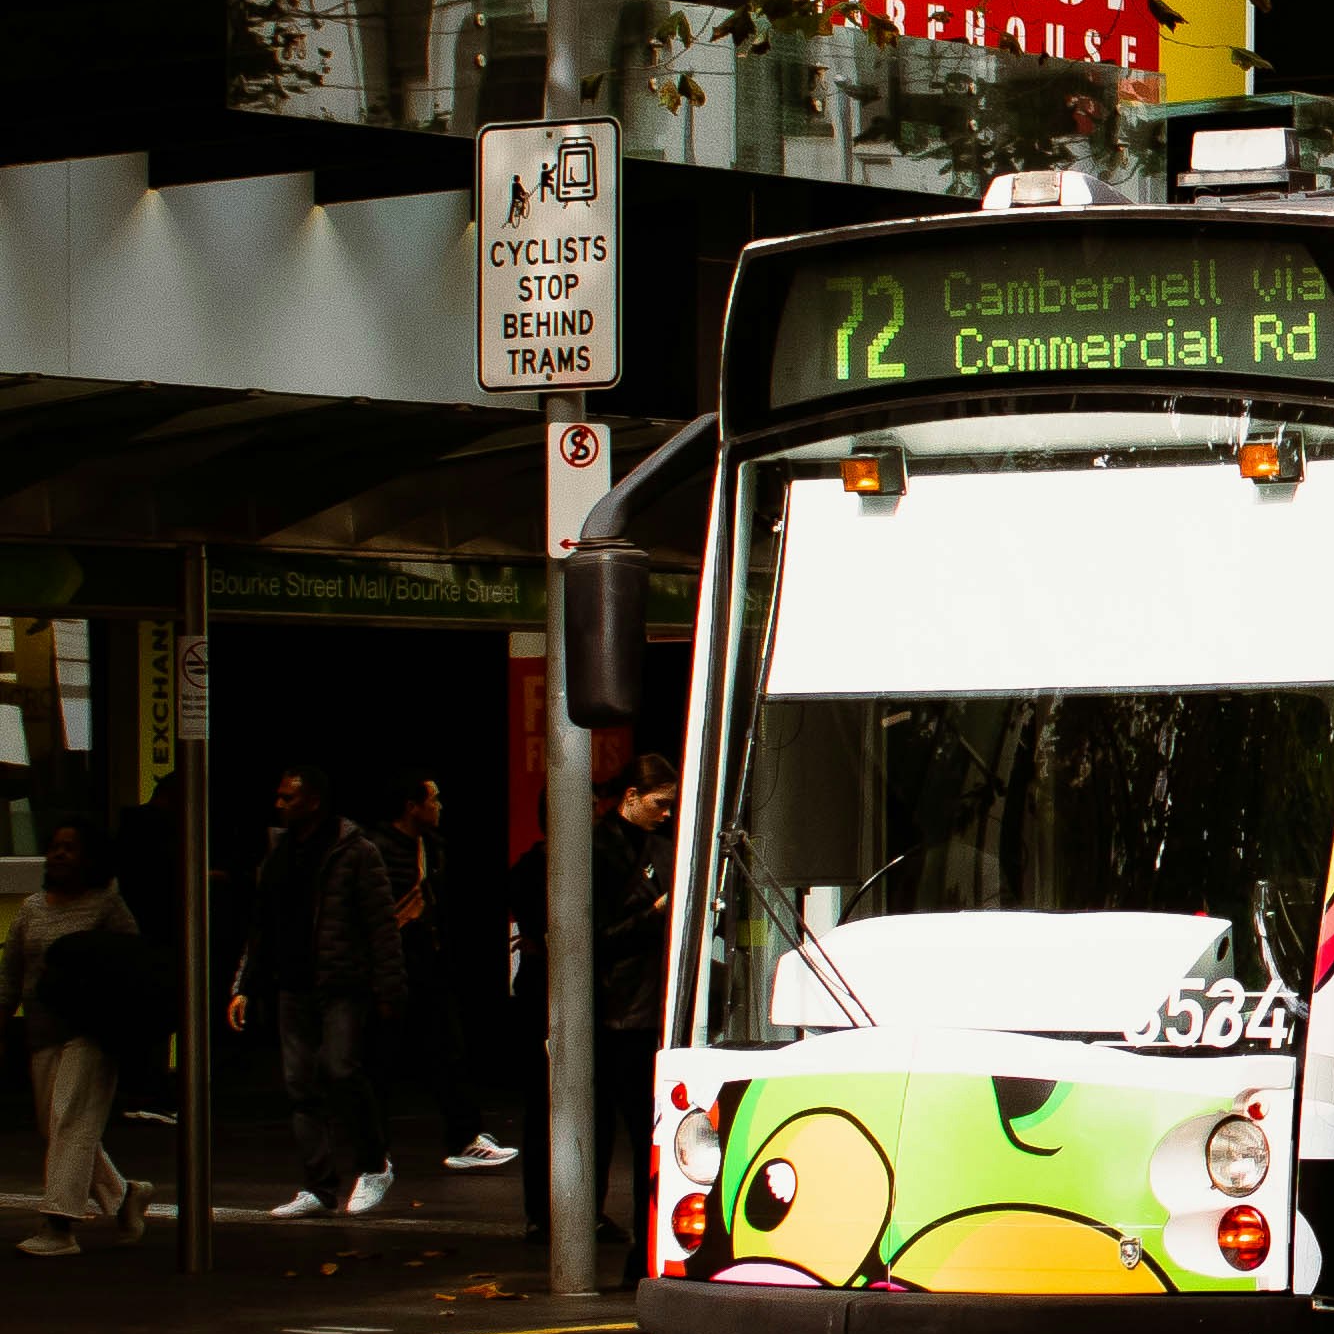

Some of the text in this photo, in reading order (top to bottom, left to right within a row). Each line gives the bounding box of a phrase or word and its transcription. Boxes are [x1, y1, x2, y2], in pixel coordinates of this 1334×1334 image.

[490, 235, 607, 268] CYCLISTS
[517, 274, 579, 302] STOP
[944, 256, 1327, 317] Camberwell via
[502, 310, 594, 339] BEHIND
[827, 275, 905, 379] 72
[506, 346, 591, 375] TRAMS
[954, 313, 1317, 375] Commercial Rd
[211, 569, 519, 605] Bourke Street Mall/Bourke Street
